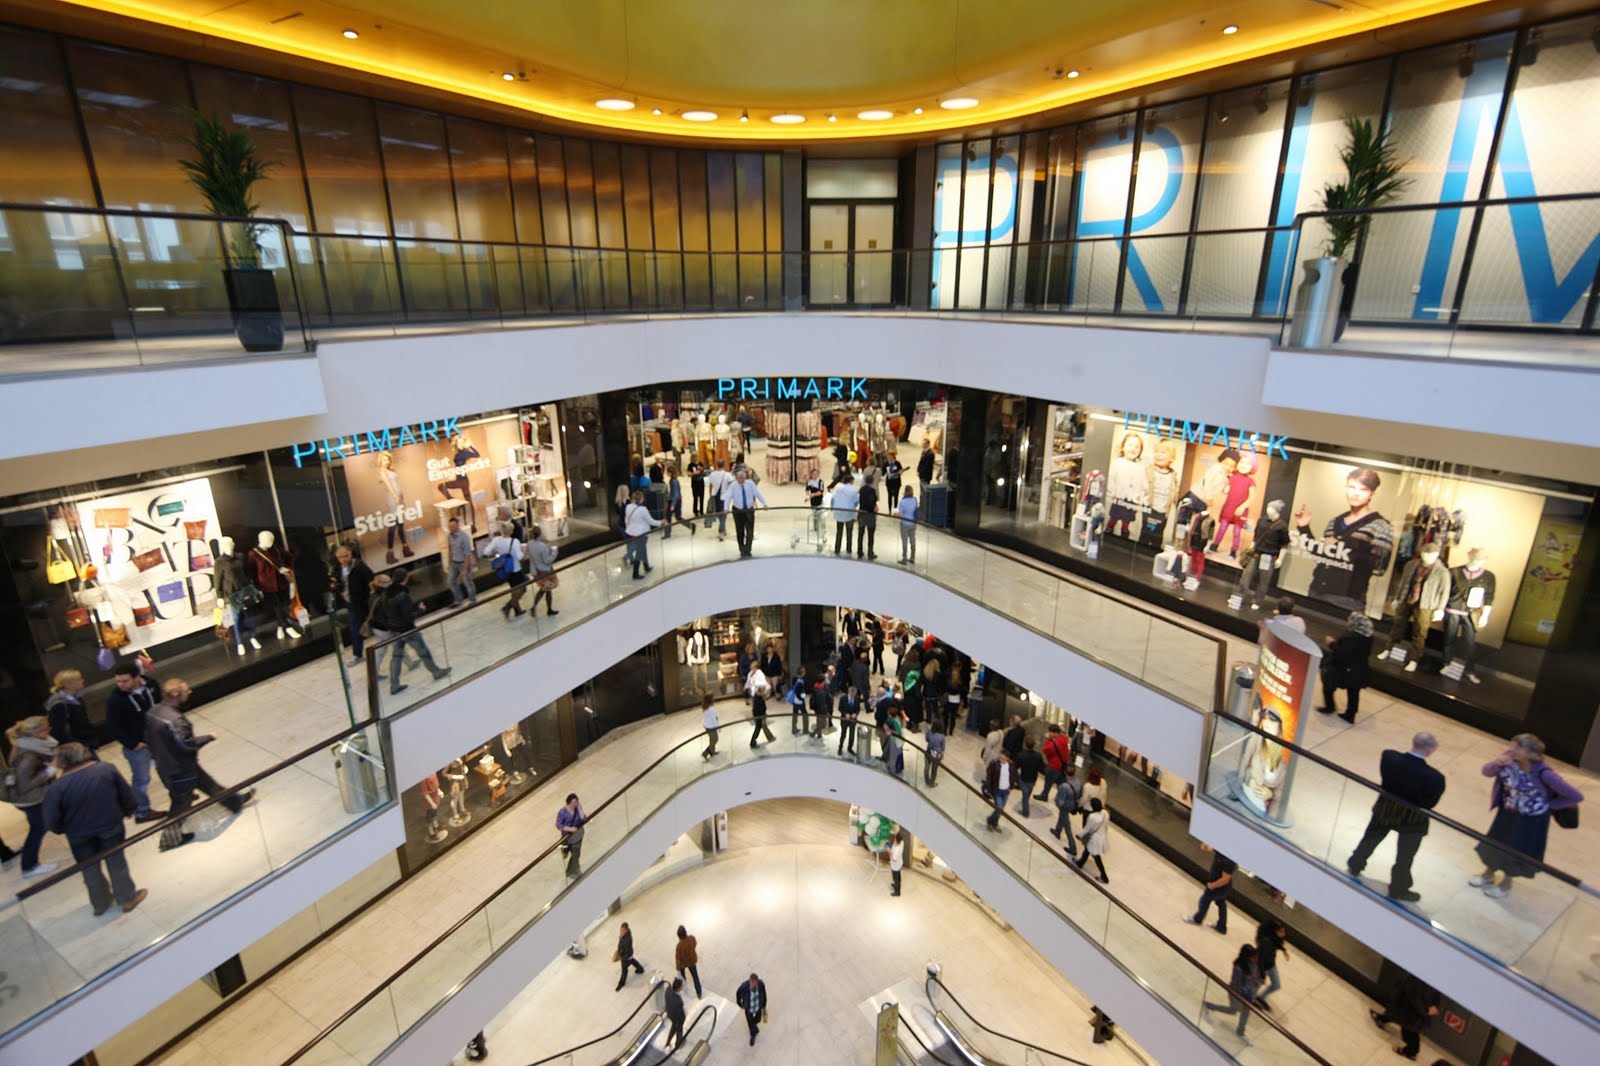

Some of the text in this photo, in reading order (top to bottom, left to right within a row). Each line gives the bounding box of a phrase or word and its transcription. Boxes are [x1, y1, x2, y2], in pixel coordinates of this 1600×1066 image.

[718, 377, 868, 400] PRIMARK
[292, 416, 462, 469] PRIMARK
[1124, 411, 1289, 460] PRIMARK
[426, 456, 451, 471] Gut
[428, 457, 492, 481] Eingepackt
[353, 500, 424, 536] Stiefel
[1289, 529, 1352, 562] Strick
